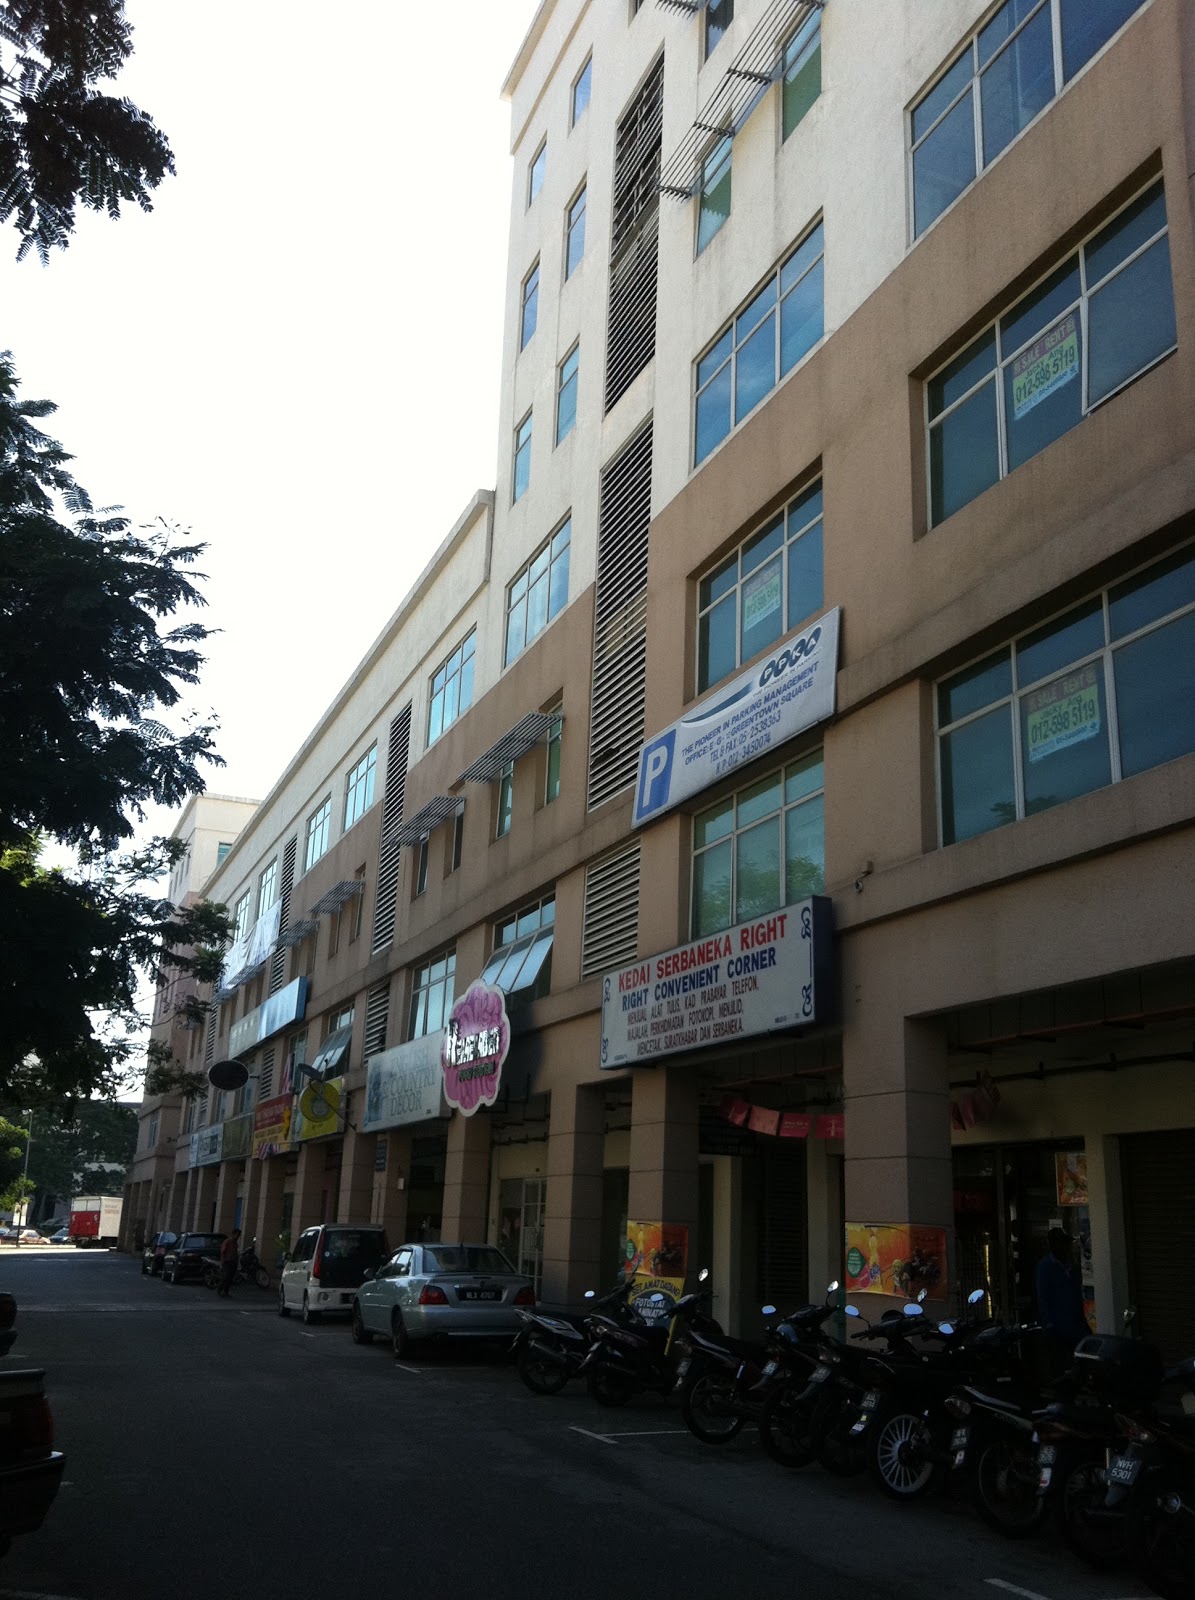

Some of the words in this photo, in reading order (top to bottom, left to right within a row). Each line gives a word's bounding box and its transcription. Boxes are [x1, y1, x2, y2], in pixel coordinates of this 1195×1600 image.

[764, 637, 817, 681] PPKA
[681, 743, 693, 757] THE
[694, 726, 721, 747] PIONEER
[722, 719, 730, 730] IN
[730, 699, 762, 724] PARKING
[763, 662, 818, 703] MANAGEMENT
[730, 700, 779, 735] GREENTOWN
[779, 677, 813, 704] SQUARE
[643, 746, 668, 808] P
[618, 964, 650, 991] KEDAI
[656, 934, 732, 978] SERBANEKA
[739, 914, 788, 950] RIGHT
[622, 989, 648, 1010] RIGHT
[654, 965, 720, 999] CONVENIENT
[727, 946, 776, 978] CORNER
[650, 1003, 662, 1018] ALAT
[684, 993, 695, 1009] KAD
[700, 985, 726, 1003] PRABAYAR
[699, 1025, 710, 1040] DAN
[390, 1064, 436, 1095] COUNTRY
[390, 1089, 423, 1114] DECOR
